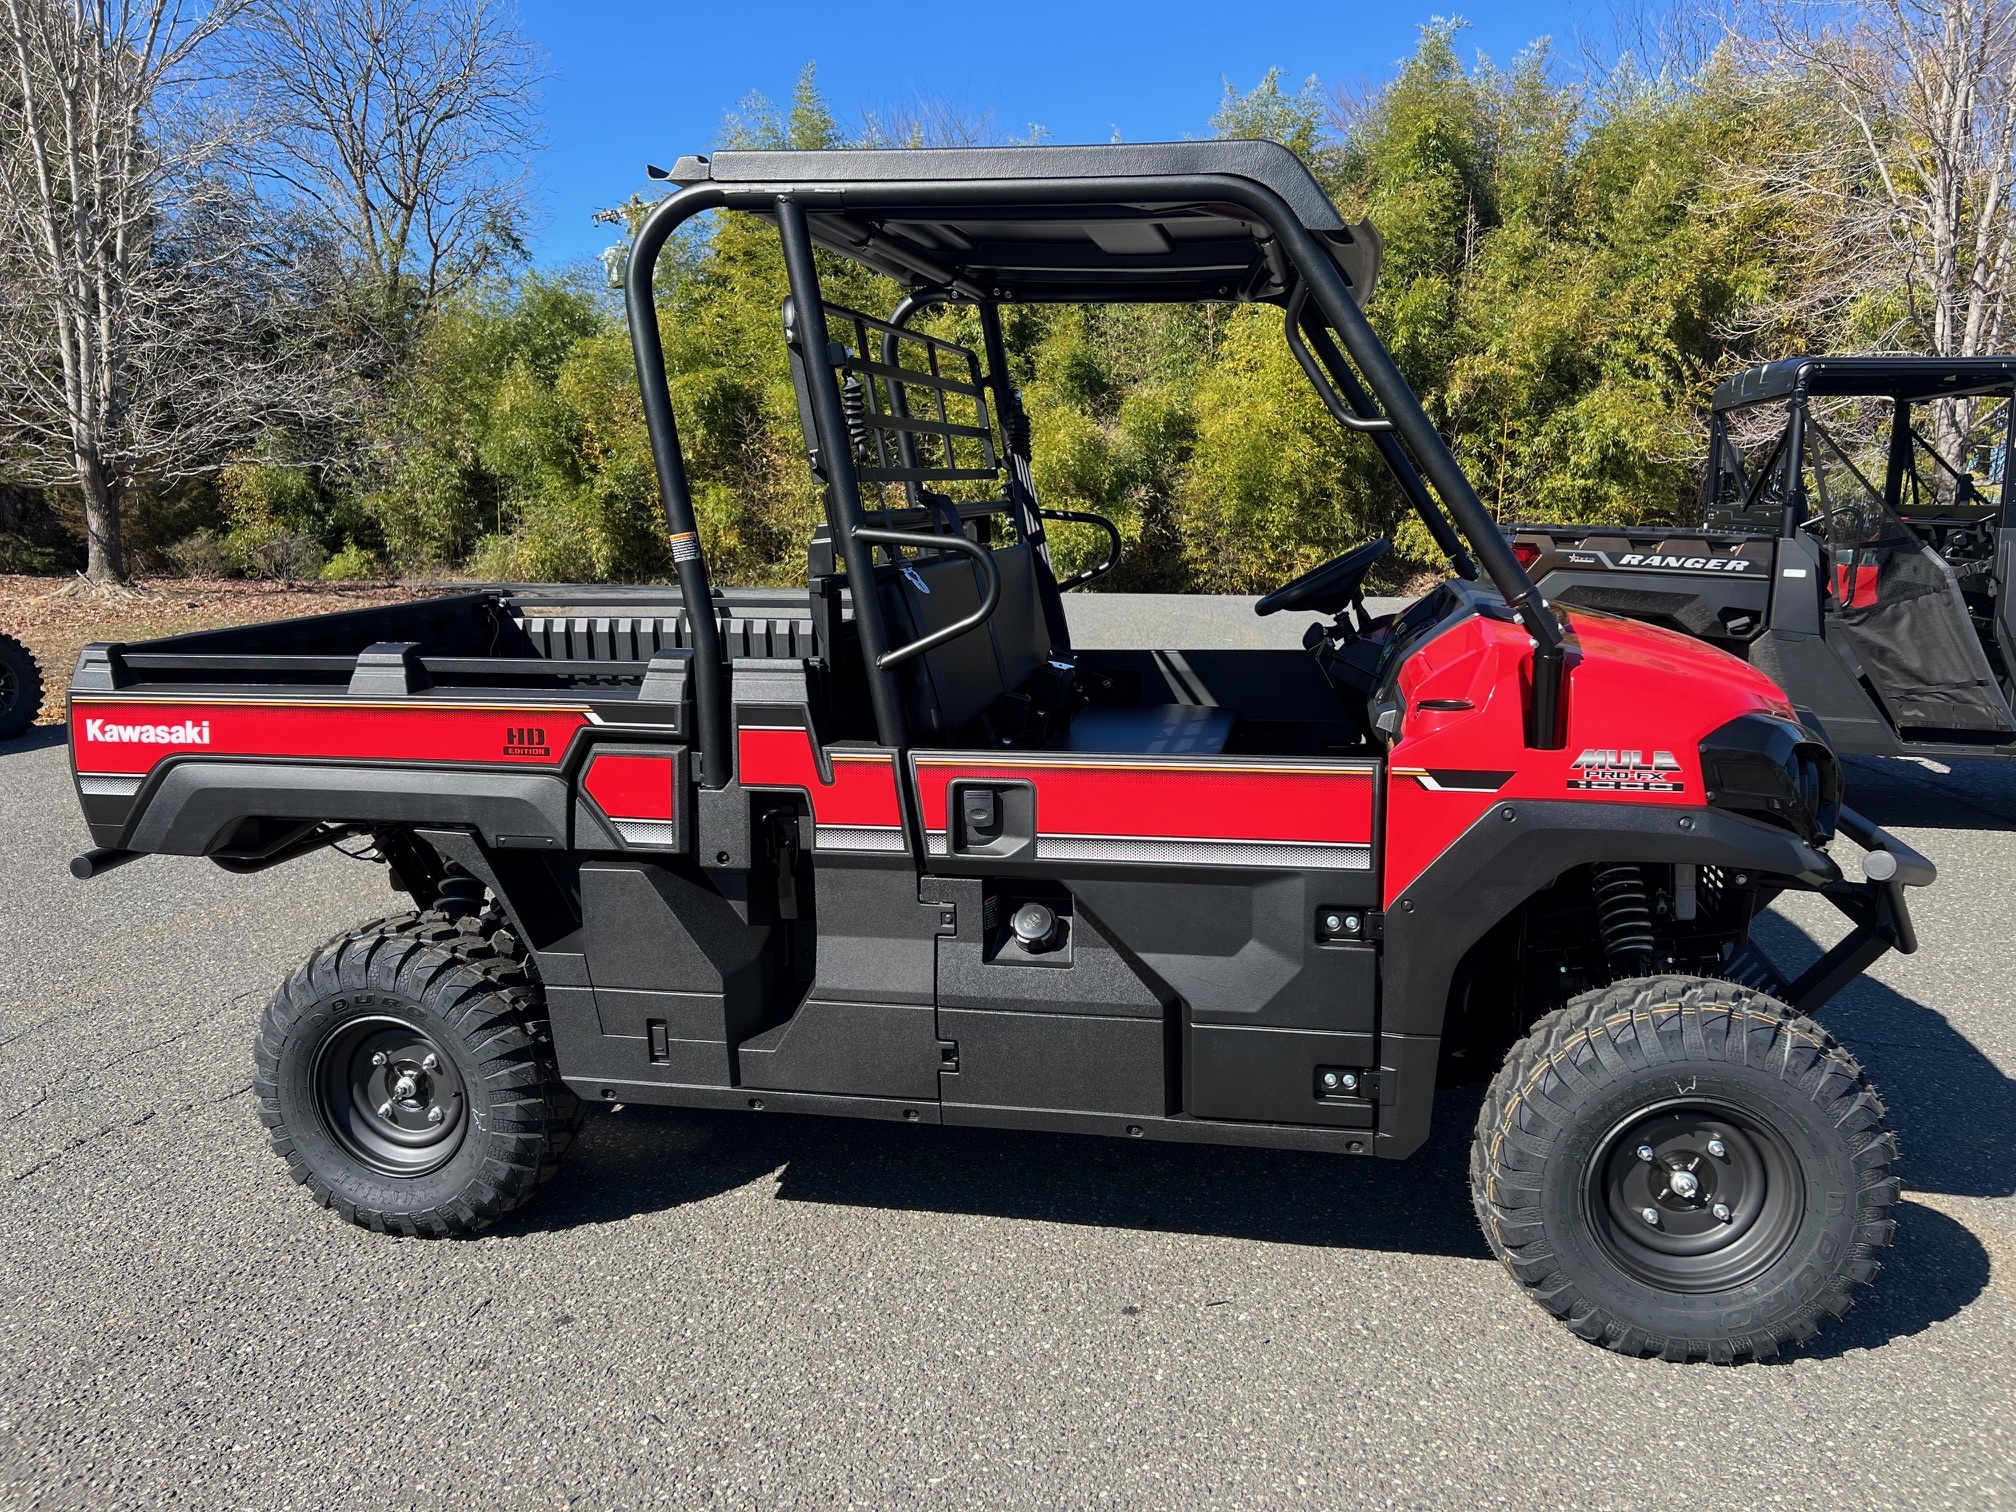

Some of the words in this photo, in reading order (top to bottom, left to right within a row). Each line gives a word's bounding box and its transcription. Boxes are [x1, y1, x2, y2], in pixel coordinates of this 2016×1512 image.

[1618, 553, 1750, 572] RANGER
[85, 718, 211, 745] Kawasaki
[506, 727, 546, 746] HD
[508, 747, 546, 756] EDITION
[1569, 748, 1683, 773] MULE
[1584, 770, 1668, 782] PRO-FX
[1577, 780, 1674, 792] 1000
[331, 993, 428, 1021] DURO
[1721, 1227, 1839, 1331] DURO
